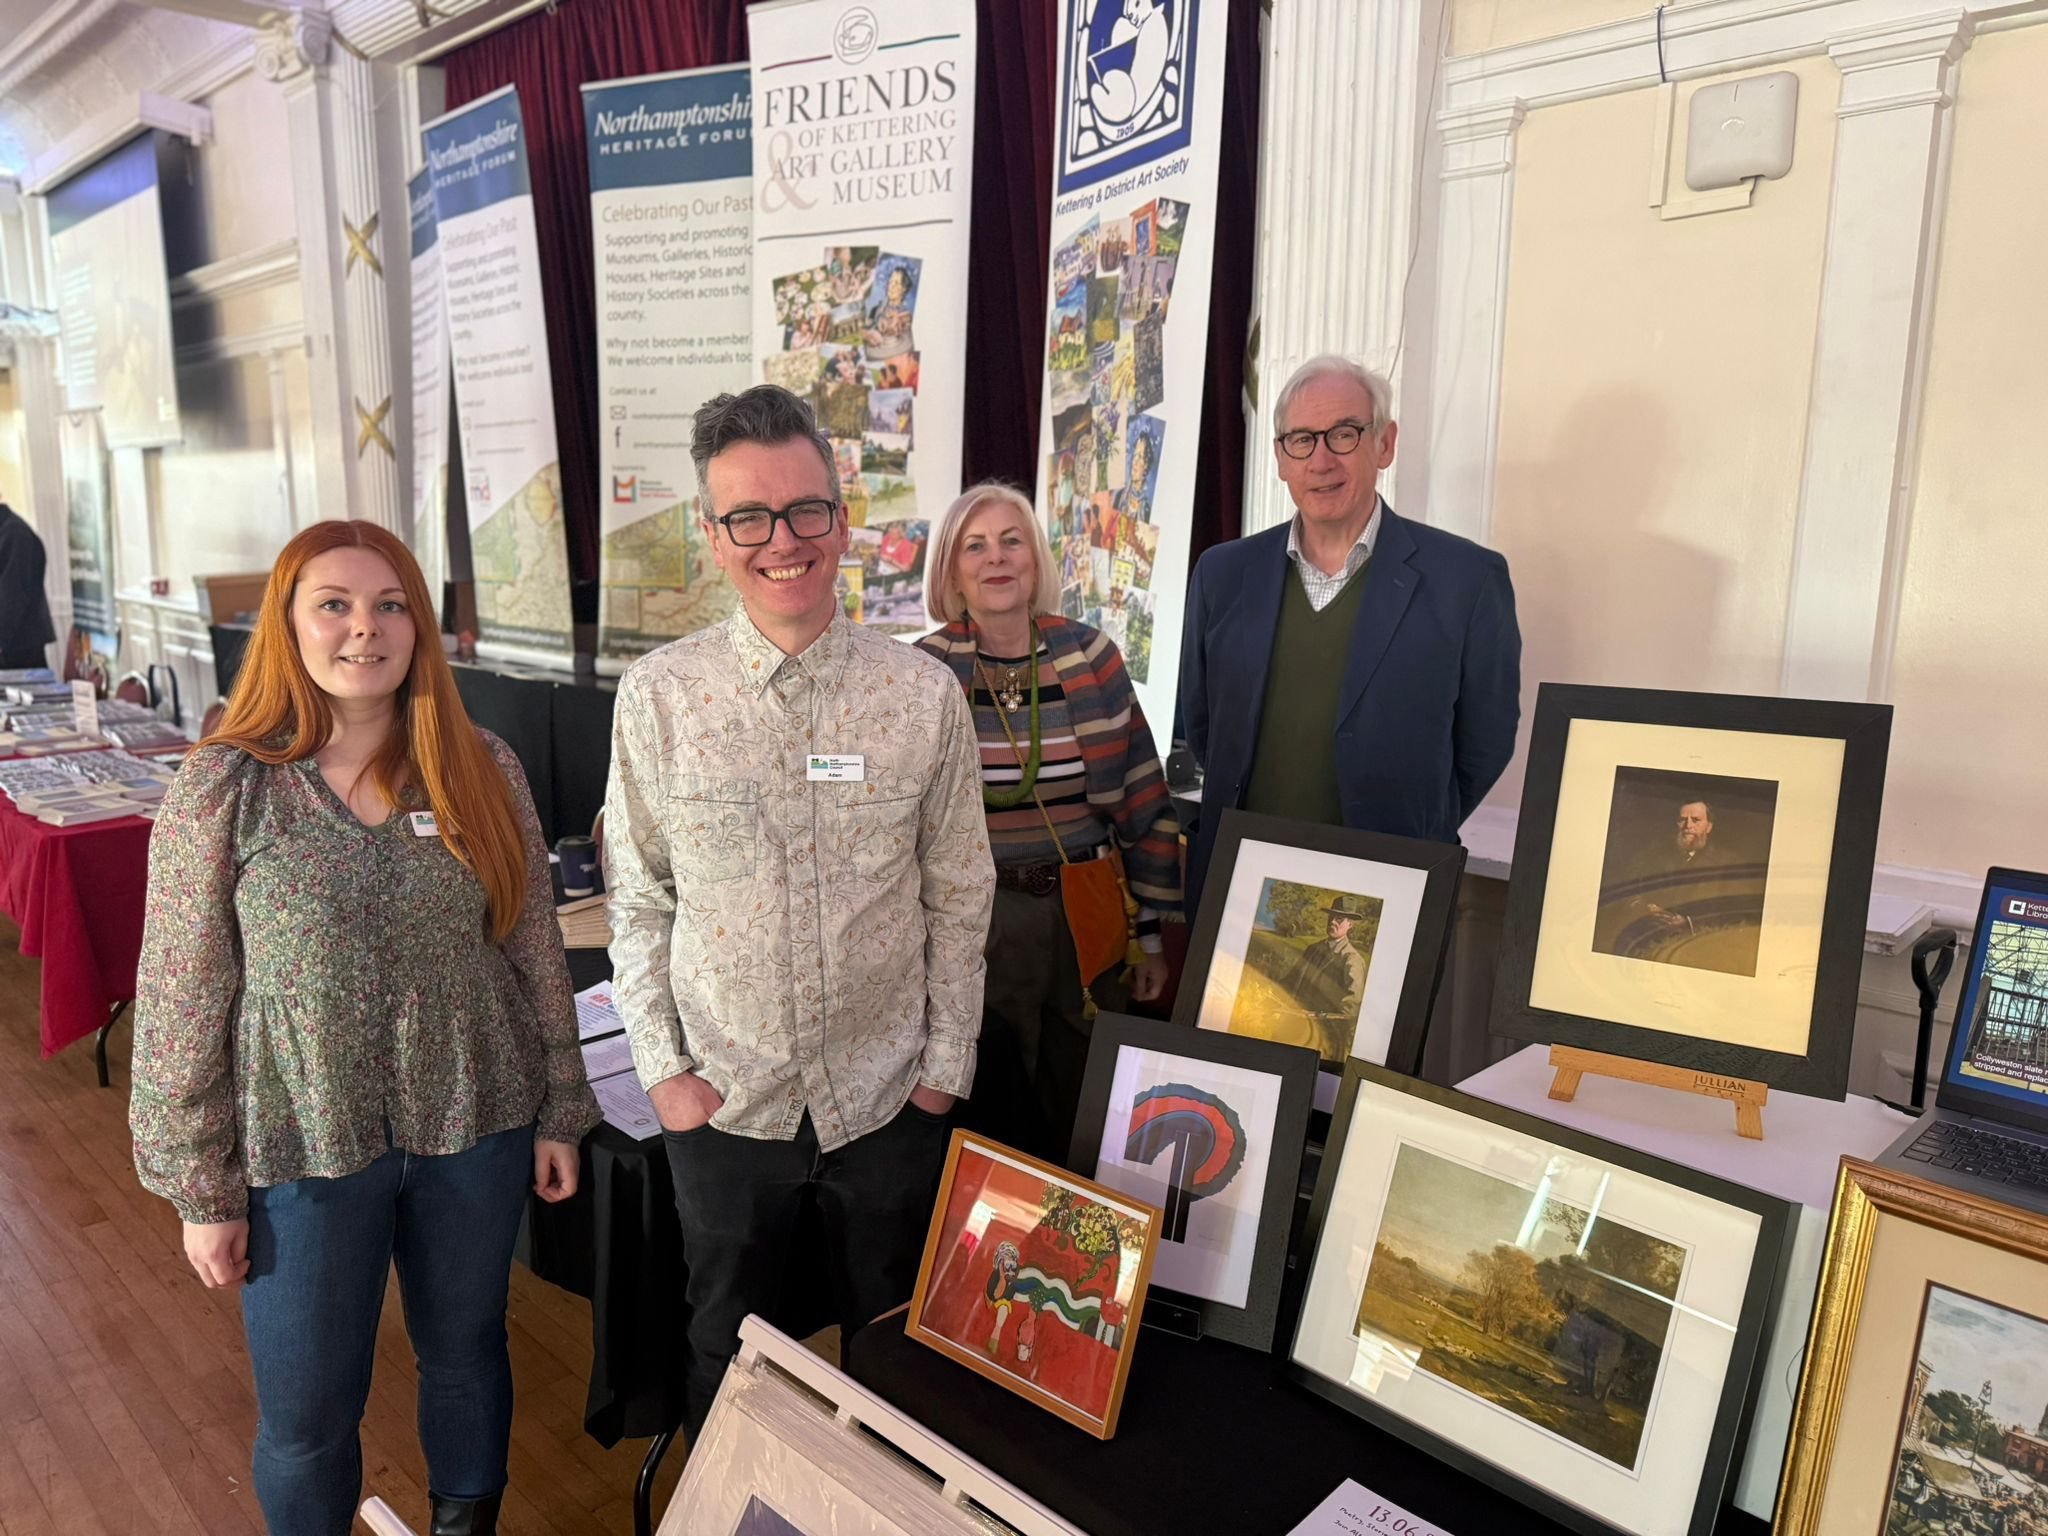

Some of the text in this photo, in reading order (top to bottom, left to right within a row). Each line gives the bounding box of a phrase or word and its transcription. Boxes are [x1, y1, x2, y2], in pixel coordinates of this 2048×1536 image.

[763, 60, 957, 129] FRIENDS
[798, 109, 956, 149] OF KETTERING
[600, 127, 753, 155] HERITAGE FORU
[771, 136, 955, 181] ART GALLERY
[760, 130, 953, 214] & MUSEUM
[1055, 157, 1190, 217] Kettering & District Art Society
[602, 202, 689, 223] Celebrating
[692, 198, 720, 216] Our
[605, 225, 749, 247] Supporting and promoting
[605, 244, 753, 265] Museums, Galleries, Historic
[606, 263, 746, 284] Houses, Heritage Sites and
[606, 283, 750, 303] History Societies across the
[606, 309, 647, 323] county.
[605, 337, 628, 351] Why
[630, 337, 650, 349] not
[652, 335, 695, 348] become
[697, 337, 704, 347] a
[607, 355, 623, 366] We
[625, 354, 674, 366] welcome
[676, 351, 734, 365] individuals
[1973, 1061, 2006, 1074] stripped
[2007, 1069, 2023, 1078] and
[1975, 1052, 2023, 1070] Collyweston
[2024, 1064, 2043, 1074] slate
[1694, 1074, 1746, 1092] JULLIAN
